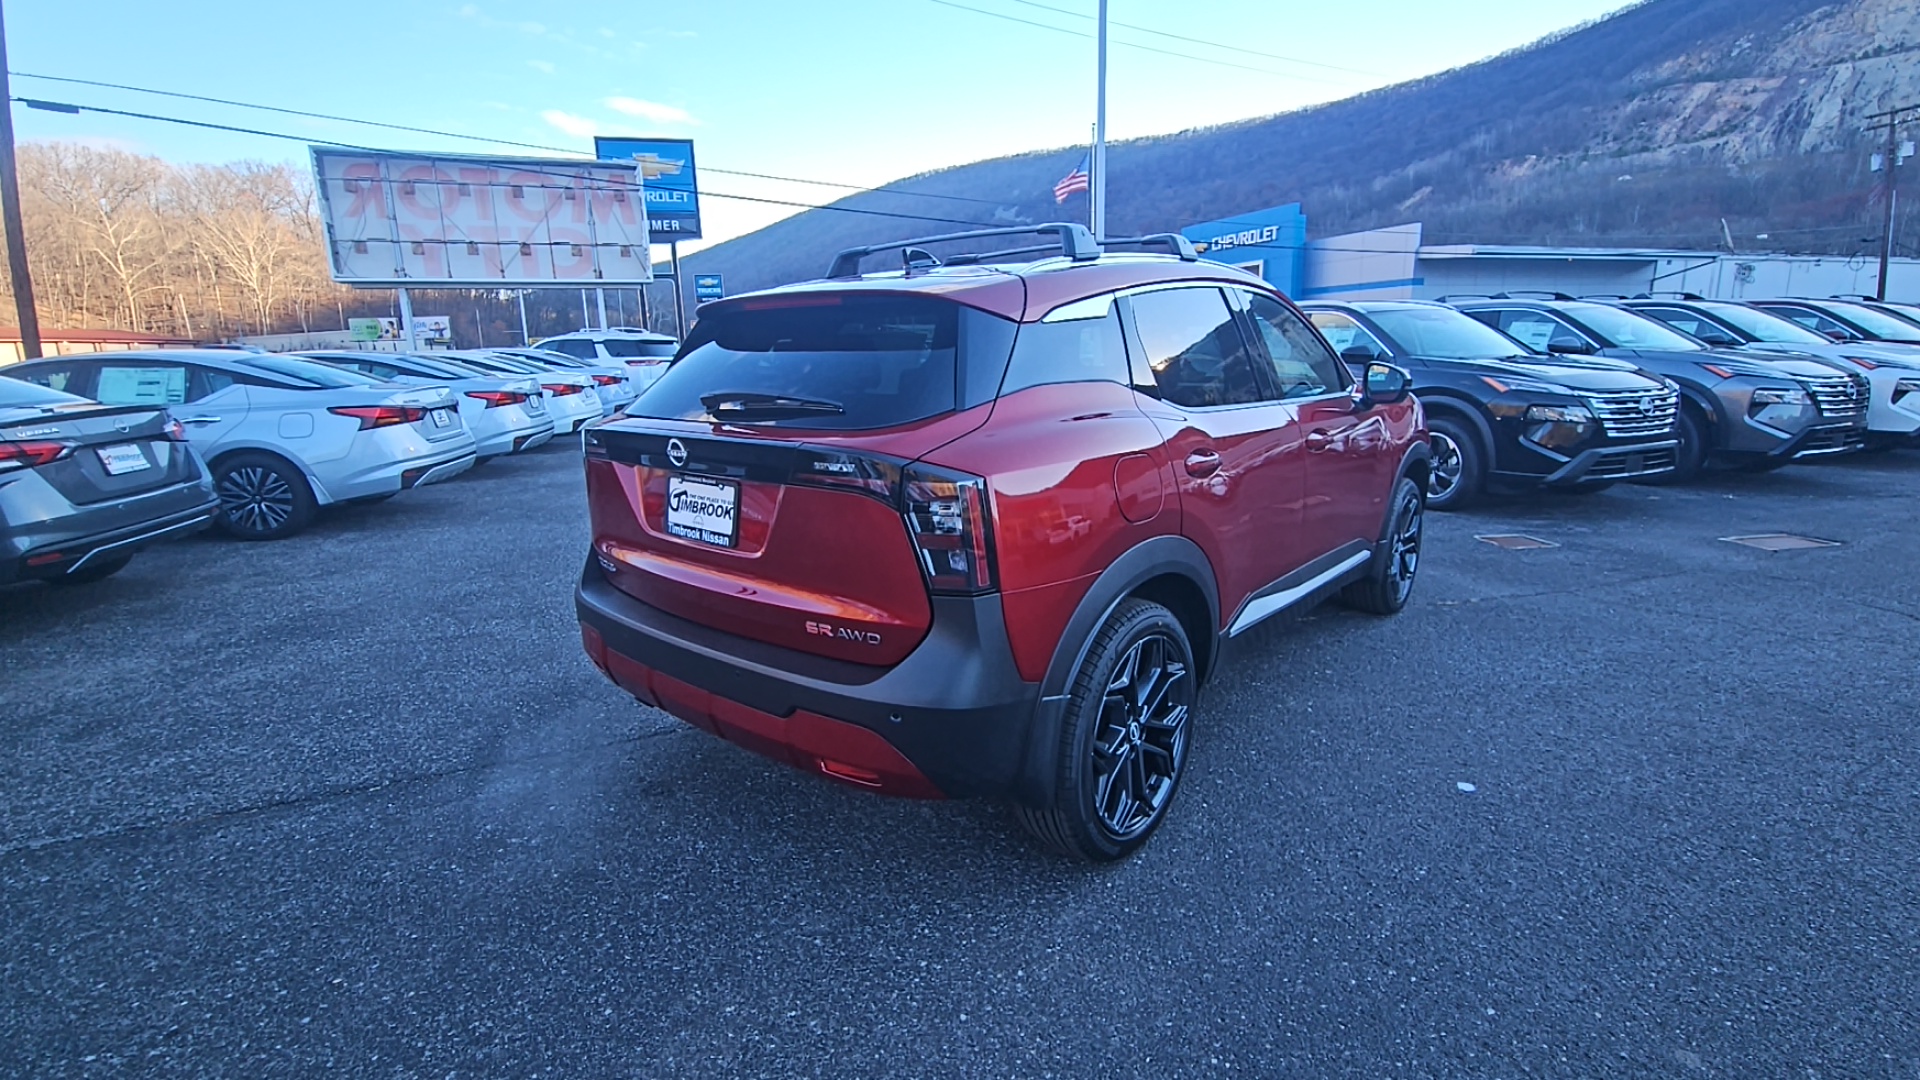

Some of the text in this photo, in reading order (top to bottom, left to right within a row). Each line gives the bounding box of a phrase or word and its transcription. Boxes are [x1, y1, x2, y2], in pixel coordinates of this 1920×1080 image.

[645, 190, 689, 202] ROLET
[649, 219, 680, 231] MER
[1211, 225, 1280, 251] CHEVROLET
[669, 487, 734, 521] TIMBROOK
[668, 522, 729, 547] Timbrook Nissan
[805, 620, 881, 645] SR AWD
